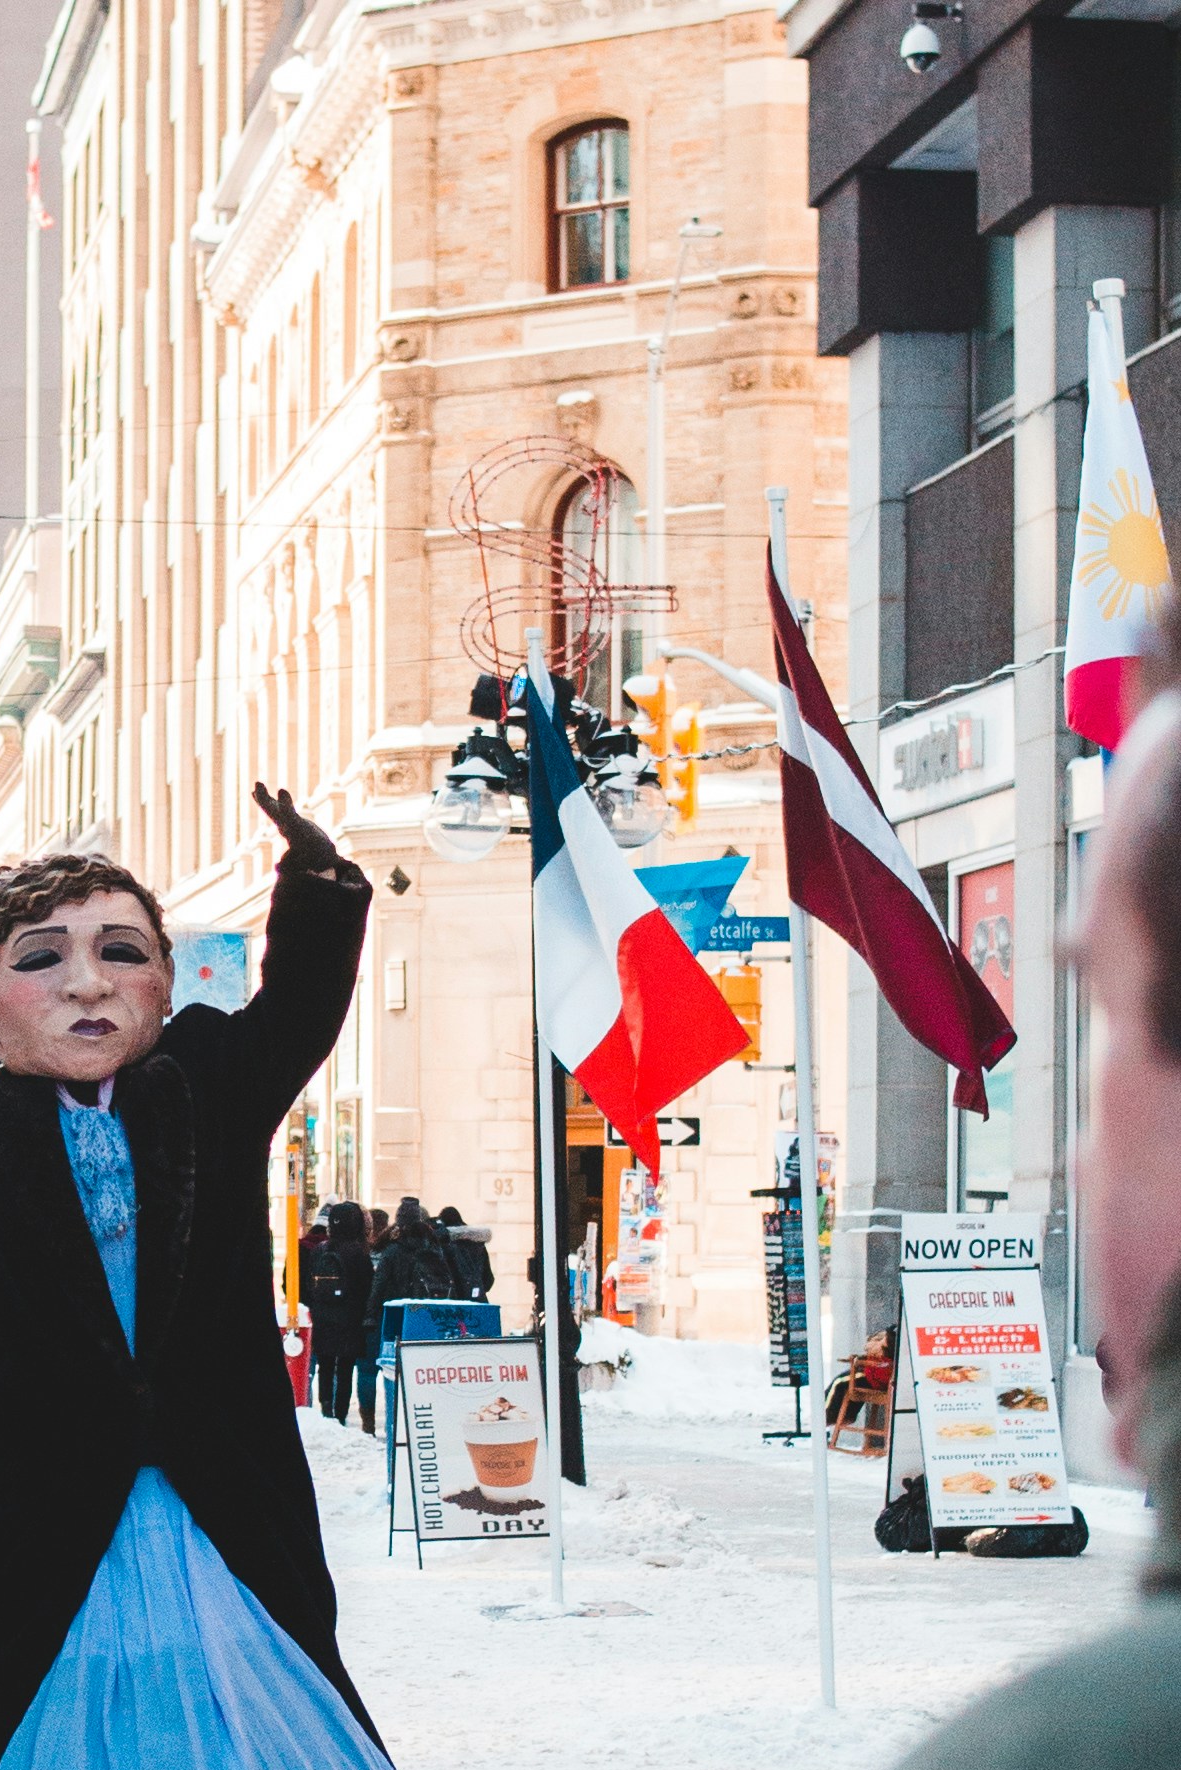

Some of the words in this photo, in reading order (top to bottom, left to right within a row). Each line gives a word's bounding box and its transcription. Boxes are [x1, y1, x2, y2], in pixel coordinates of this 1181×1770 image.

[709, 920, 761, 939] etcalfe
[493, 1177, 514, 1197] 93
[904, 1238, 962, 1260] NOW
[968, 1237, 1034, 1260] OPEN
[993, 1290, 1016, 1308] RIM
[925, 1324, 1038, 1336] Breakfast
[934, 1336, 951, 1345] &
[958, 1334, 1024, 1345] Lunch
[931, 1343, 1036, 1355] Available
[498, 1364, 529, 1382] RIM
[481, 1519, 546, 1533] DAY
